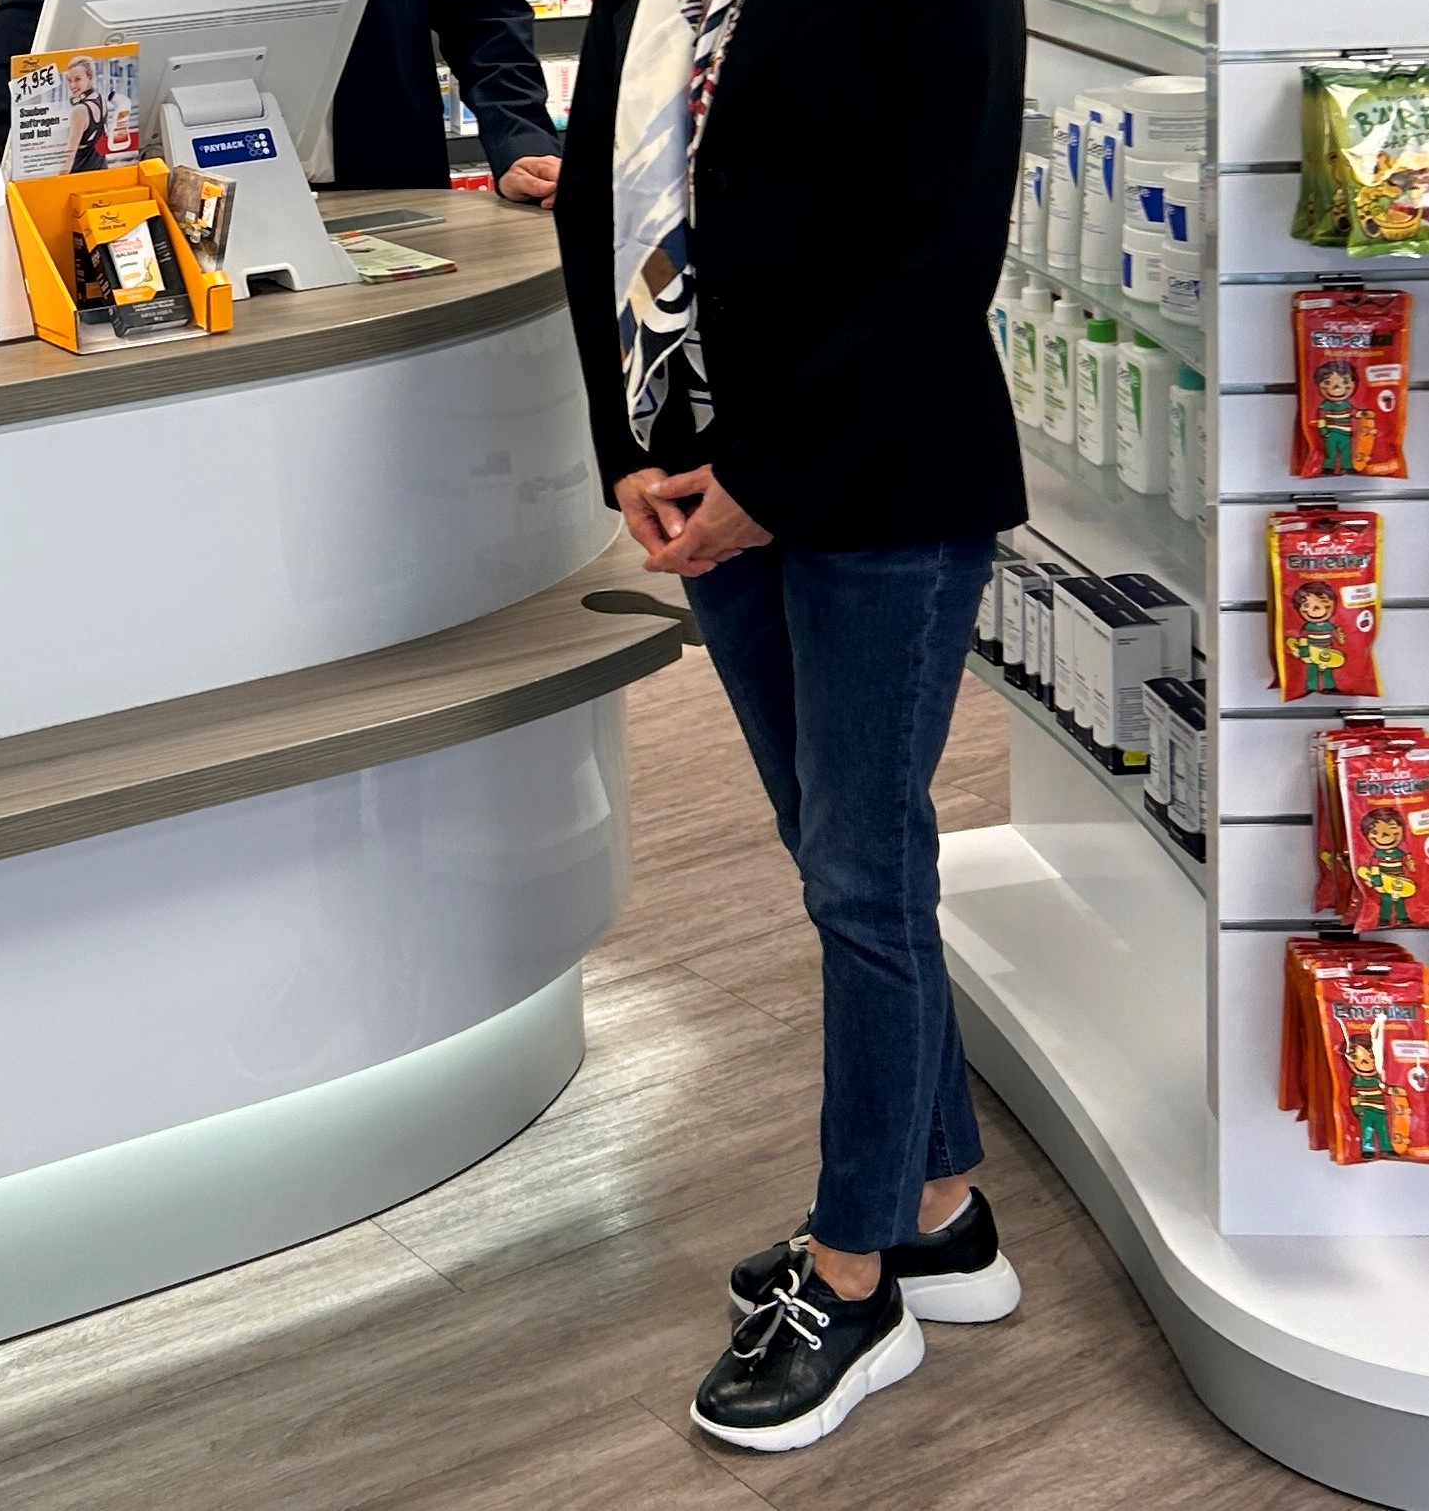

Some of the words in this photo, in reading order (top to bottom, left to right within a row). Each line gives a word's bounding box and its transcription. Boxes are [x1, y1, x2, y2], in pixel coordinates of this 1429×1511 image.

[17, 66, 54, 95] 7,95€
[20, 107, 49, 118] Sauber
[20, 117, 60, 129] auftragen
[20, 130, 34, 140] und
[37, 128, 51, 138] los!
[203, 139, 245, 154] PAYBACK
